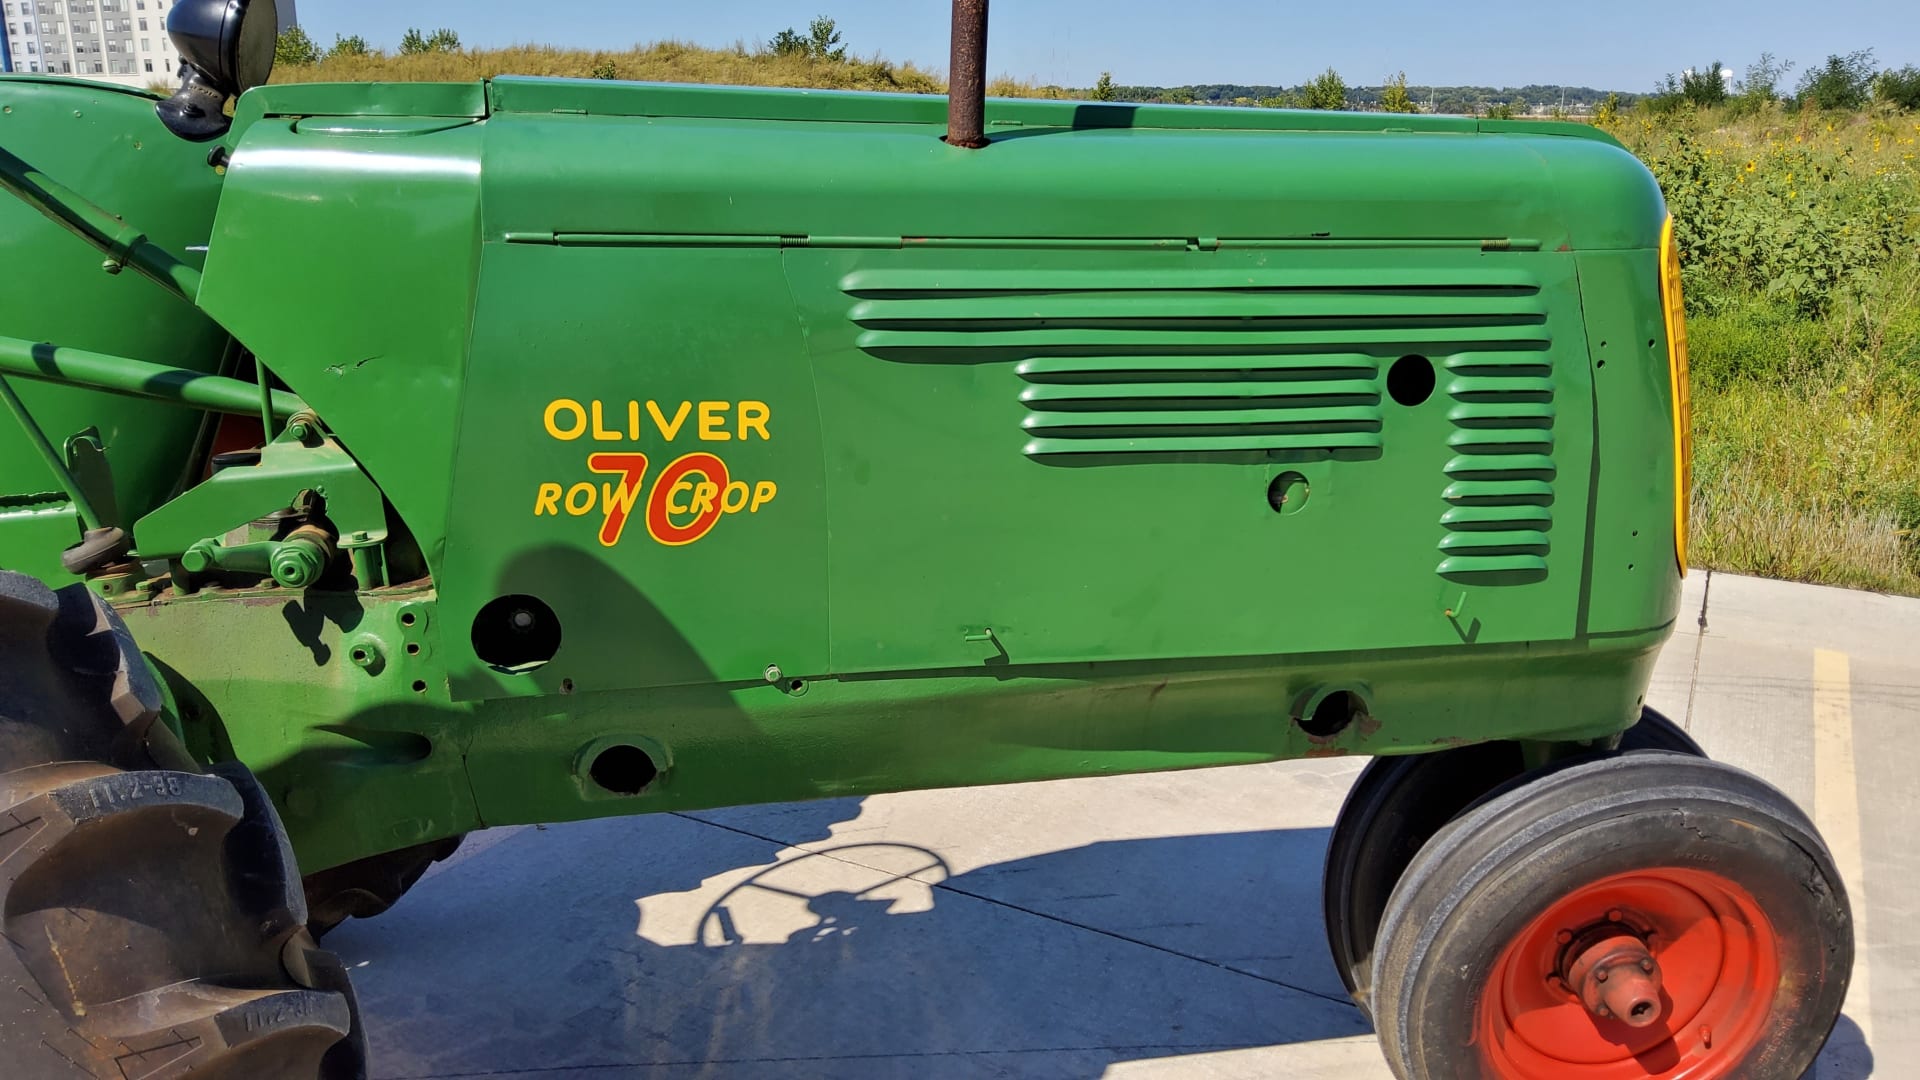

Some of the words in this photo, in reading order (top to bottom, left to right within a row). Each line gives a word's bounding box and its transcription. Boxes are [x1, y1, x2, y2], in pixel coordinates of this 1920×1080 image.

[544, 399, 771, 441] OLIVER
[534, 482, 642, 516] ROW
[666, 481, 777, 515] CROP
[587, 452, 730, 547] 70
